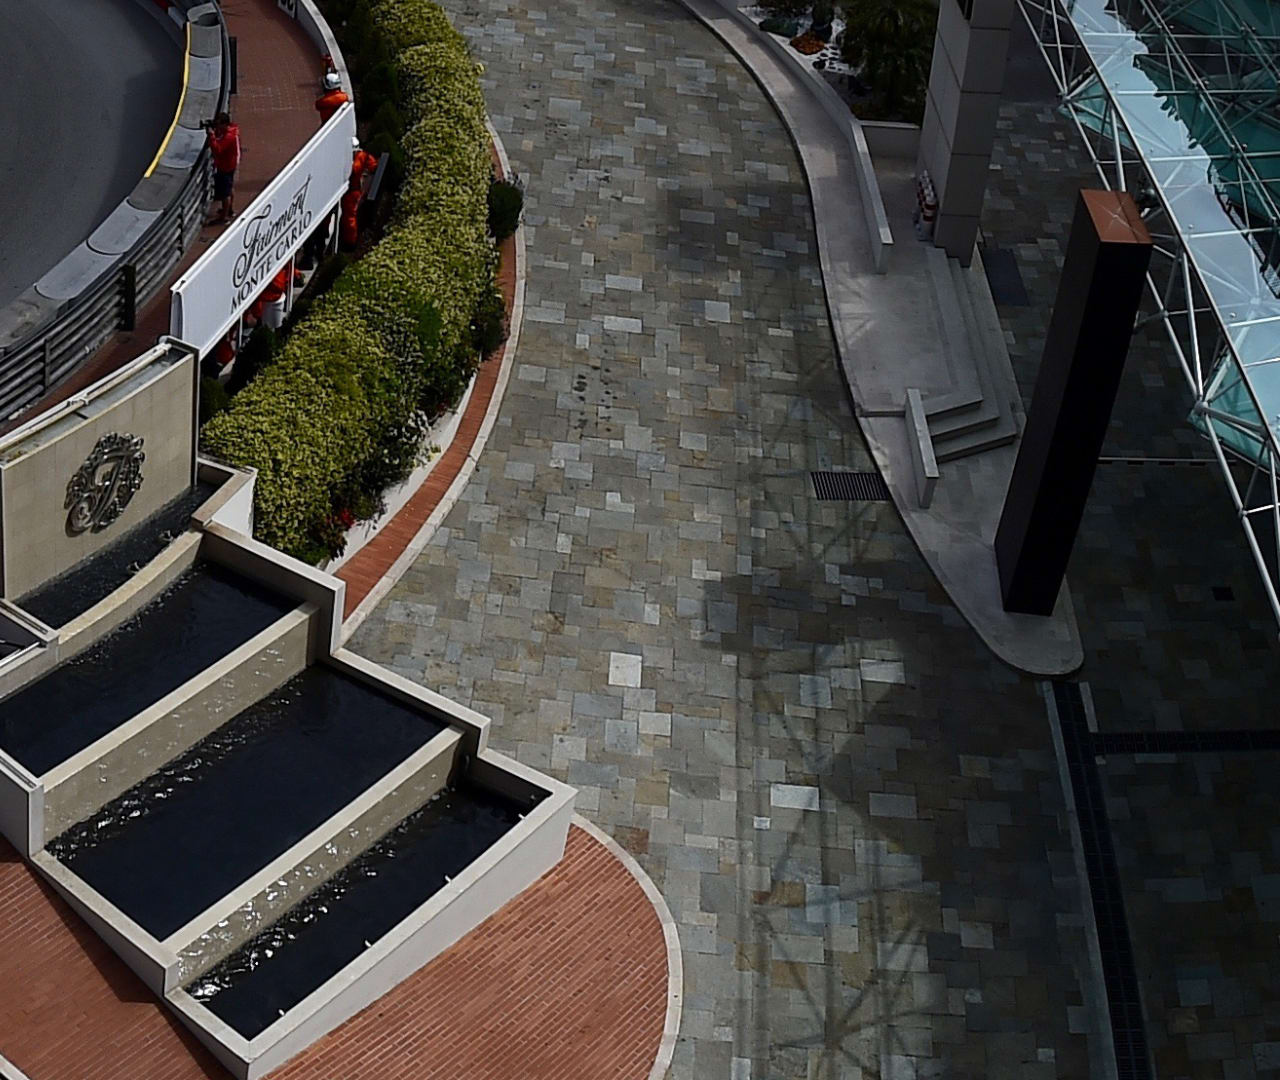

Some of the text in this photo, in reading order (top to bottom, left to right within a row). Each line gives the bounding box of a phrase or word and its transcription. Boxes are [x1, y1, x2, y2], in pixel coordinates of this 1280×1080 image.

[230, 210, 313, 314] MONTE CARLO
[233, 174, 313, 288] Fairmont
